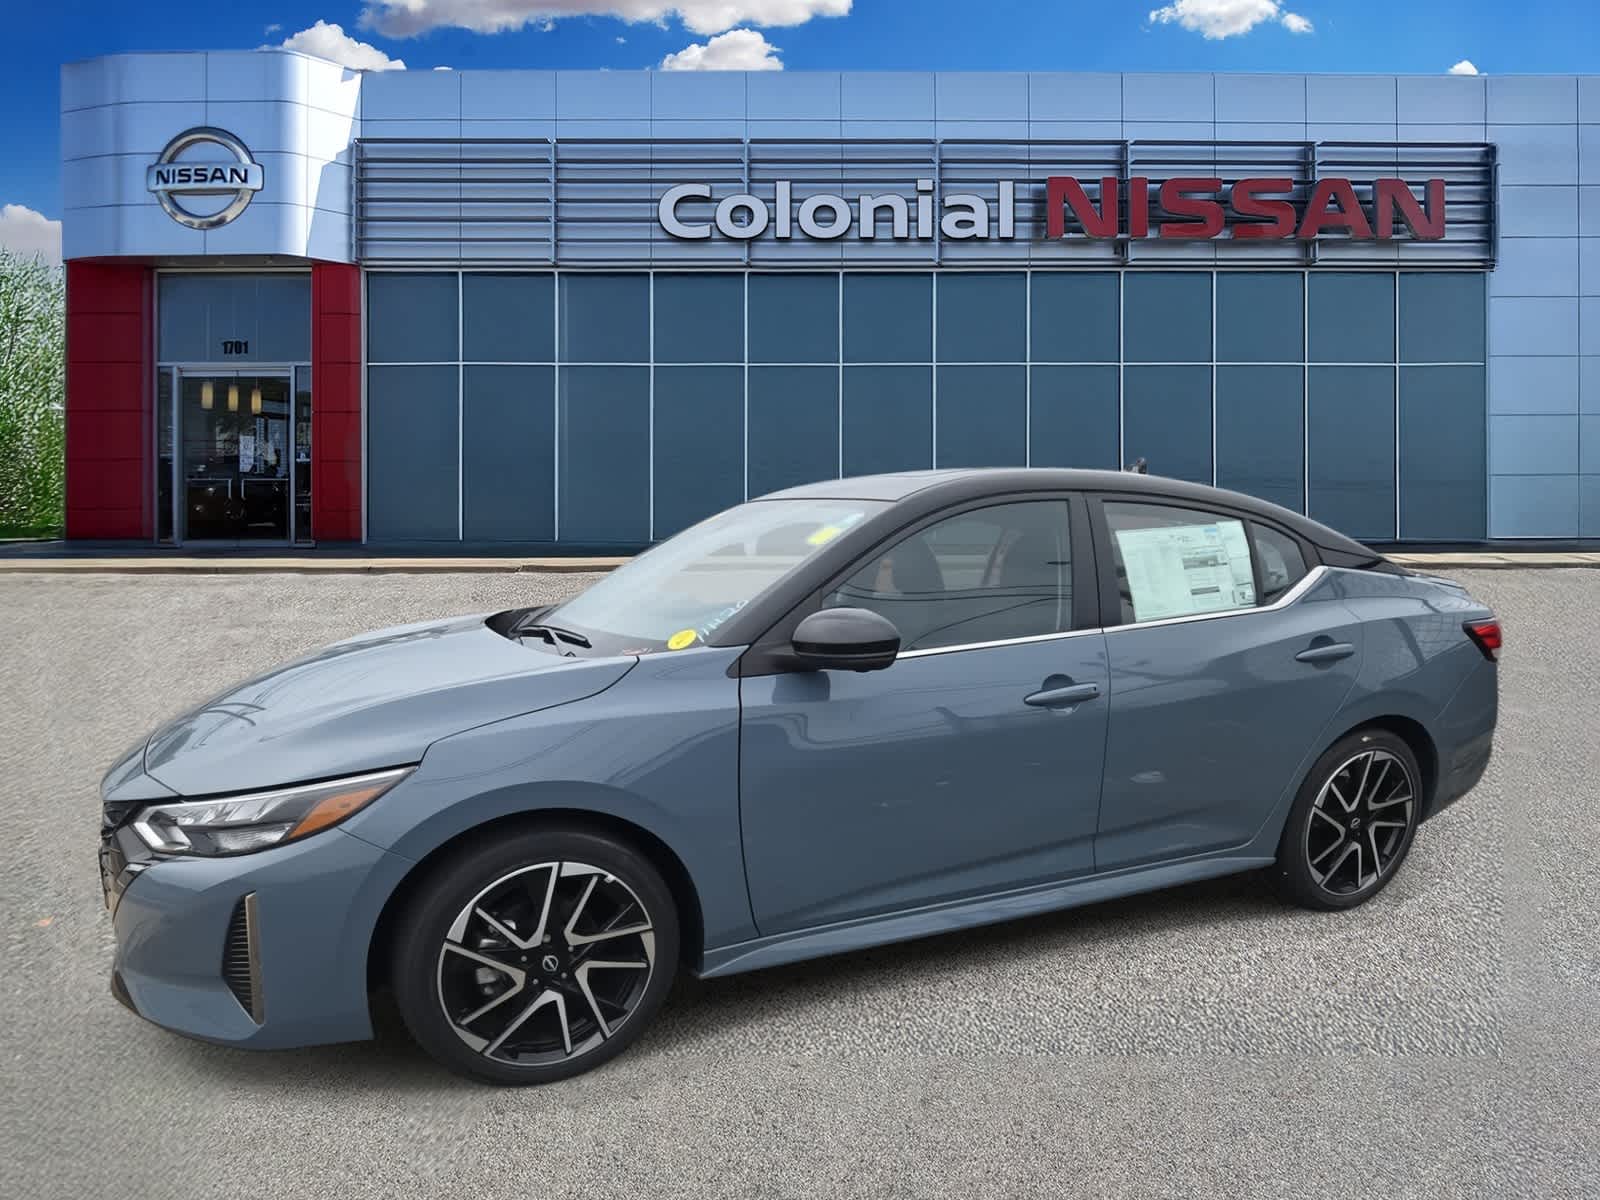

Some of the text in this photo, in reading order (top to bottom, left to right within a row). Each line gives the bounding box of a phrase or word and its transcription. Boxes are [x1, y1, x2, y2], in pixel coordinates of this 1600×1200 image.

[156, 167, 248, 185] NISSAN
[658, 176, 1446, 240] Colonial NISSAN
[221, 340, 249, 354] 1701
